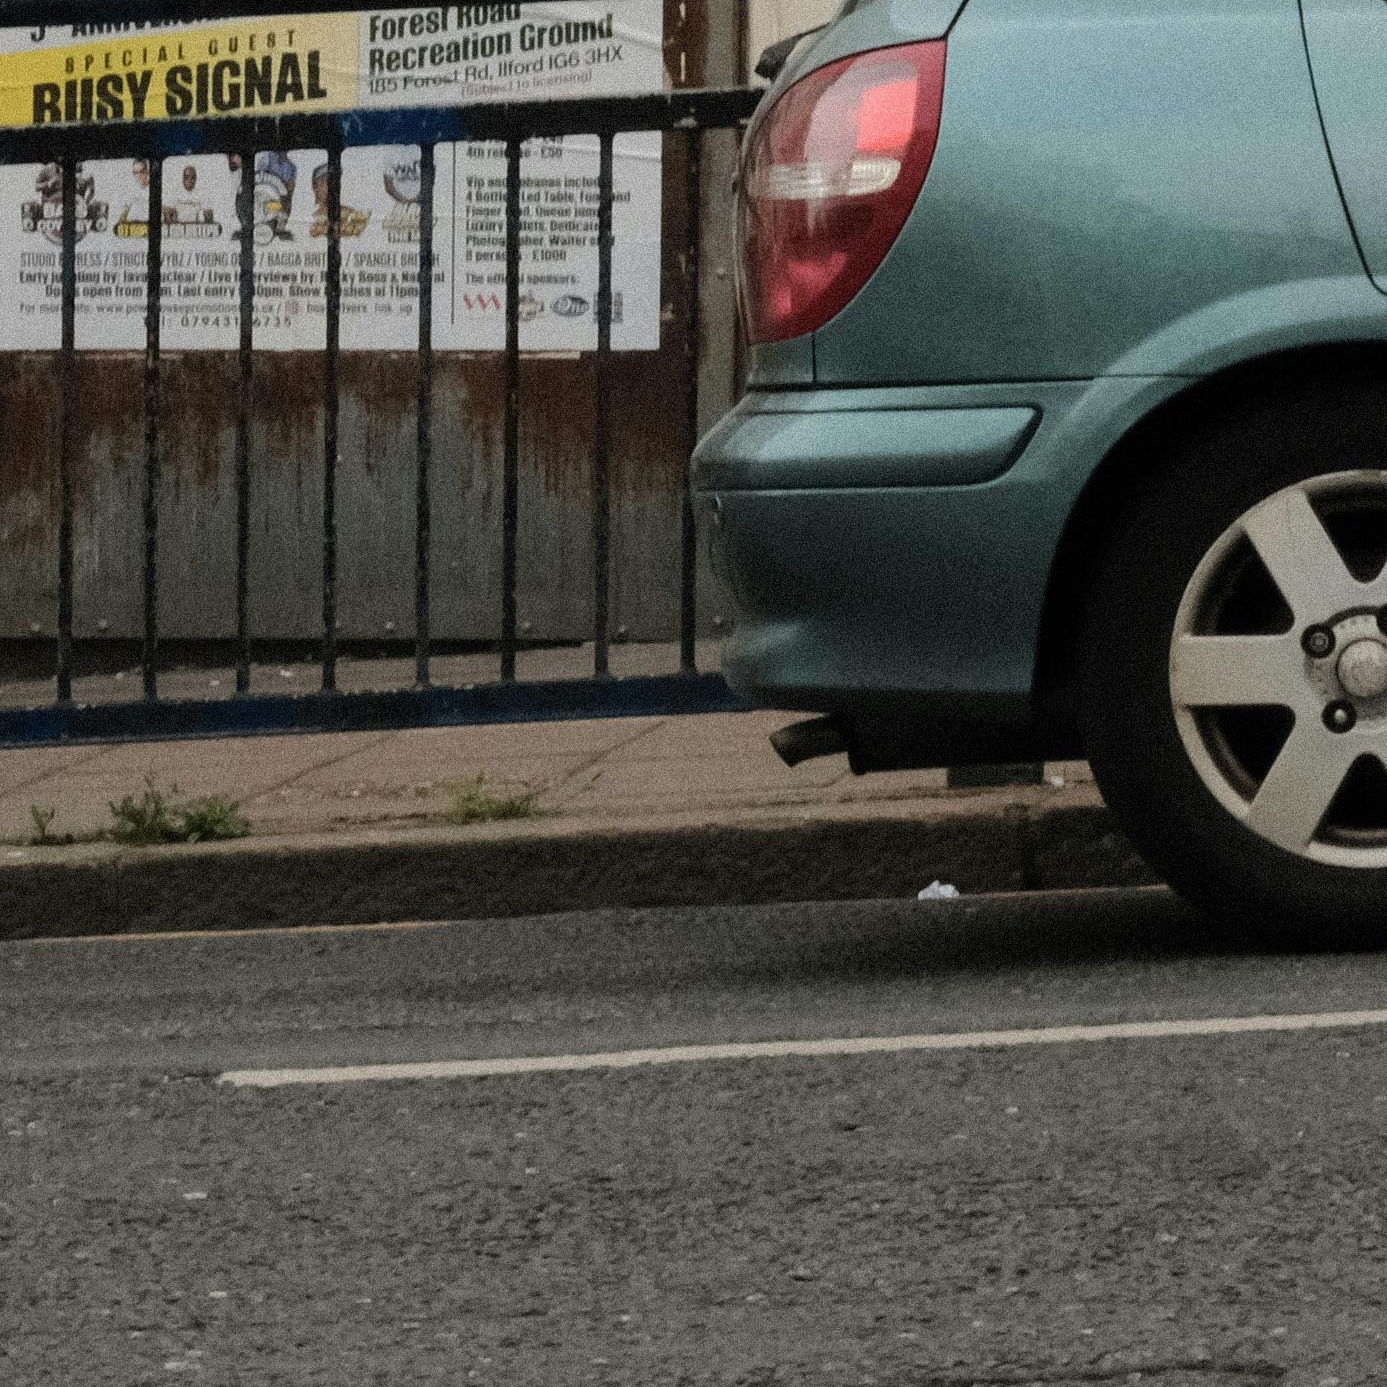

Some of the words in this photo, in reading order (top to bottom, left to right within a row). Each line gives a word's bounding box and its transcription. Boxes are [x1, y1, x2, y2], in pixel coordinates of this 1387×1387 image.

[368, 5, 449, 44] Forest
[368, 29, 512, 77] Recreation
[518, 11, 614, 53] Ground
[63, 42, 186, 76] SPECIAL
[207, 29, 298, 59] GUEST
[402, 68, 461, 90] Forest
[497, 57, 546, 79] Ilford
[549, 49, 581, 71] IG6
[583, 43, 624, 67] 3HX
[164, 48, 328, 118] SIGNAL
